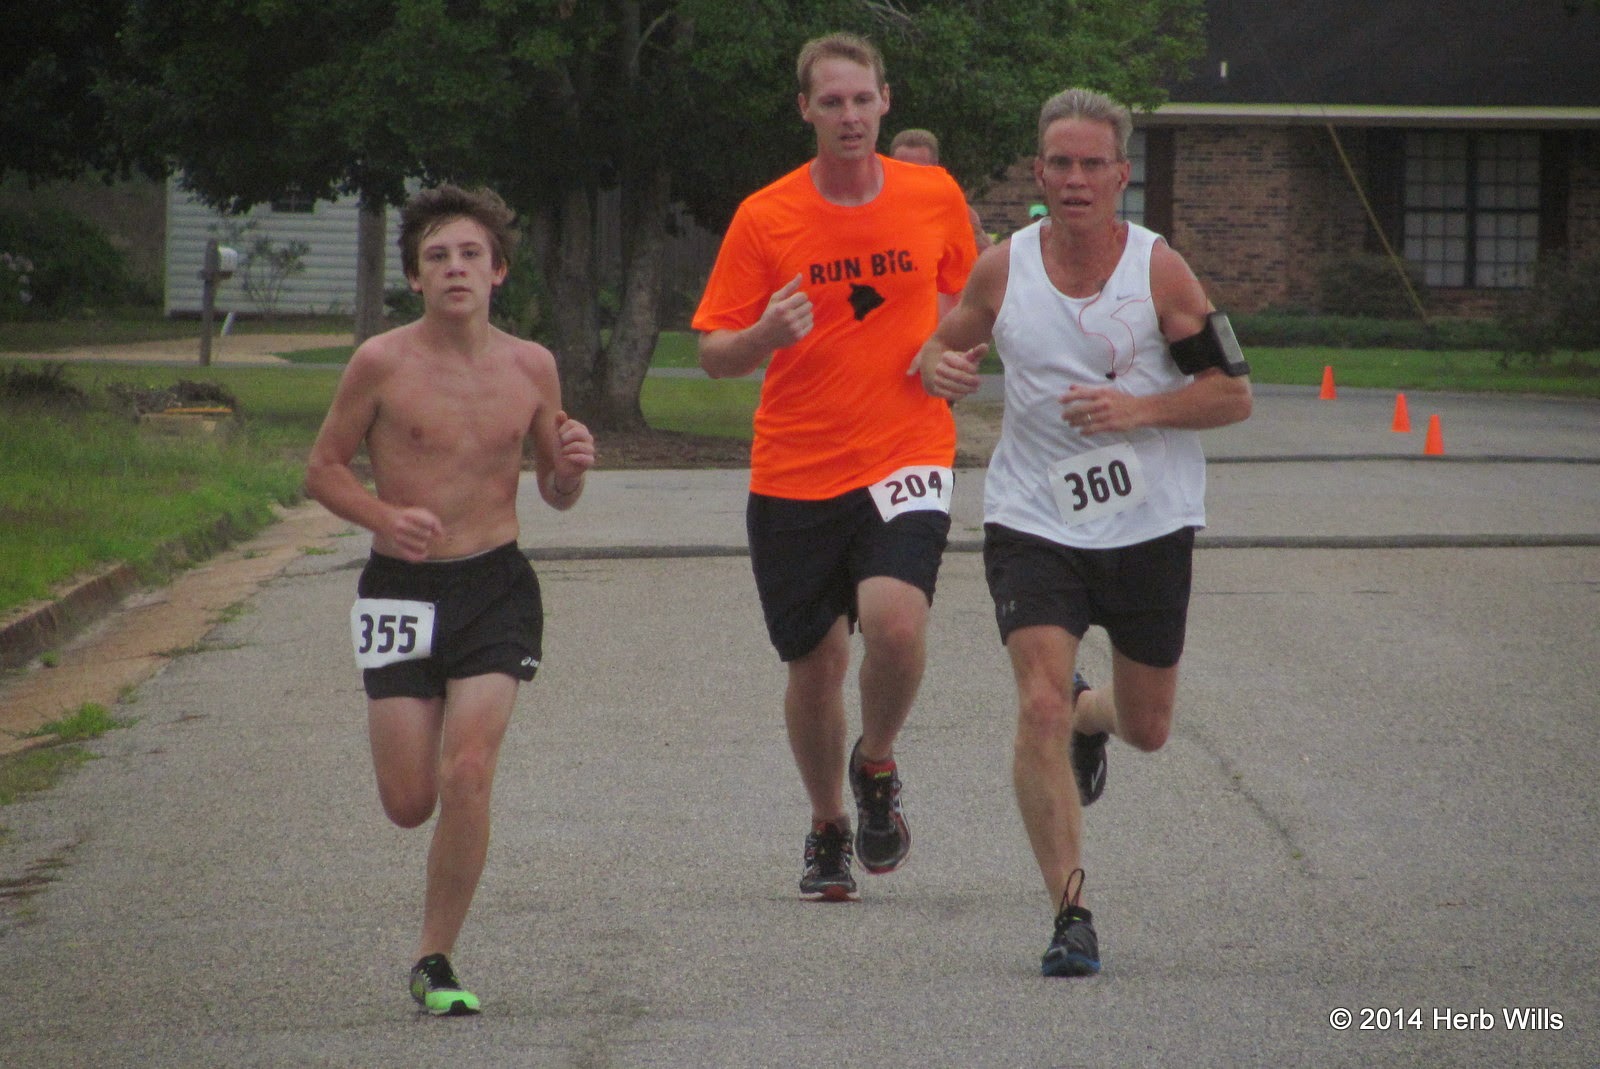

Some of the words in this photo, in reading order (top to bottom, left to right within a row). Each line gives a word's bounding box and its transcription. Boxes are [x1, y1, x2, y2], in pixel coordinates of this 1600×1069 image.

[809, 257, 862, 285] RUN
[885, 470, 943, 506] 204
[1064, 459, 1132, 511] 360
[359, 613, 418, 654] 355
